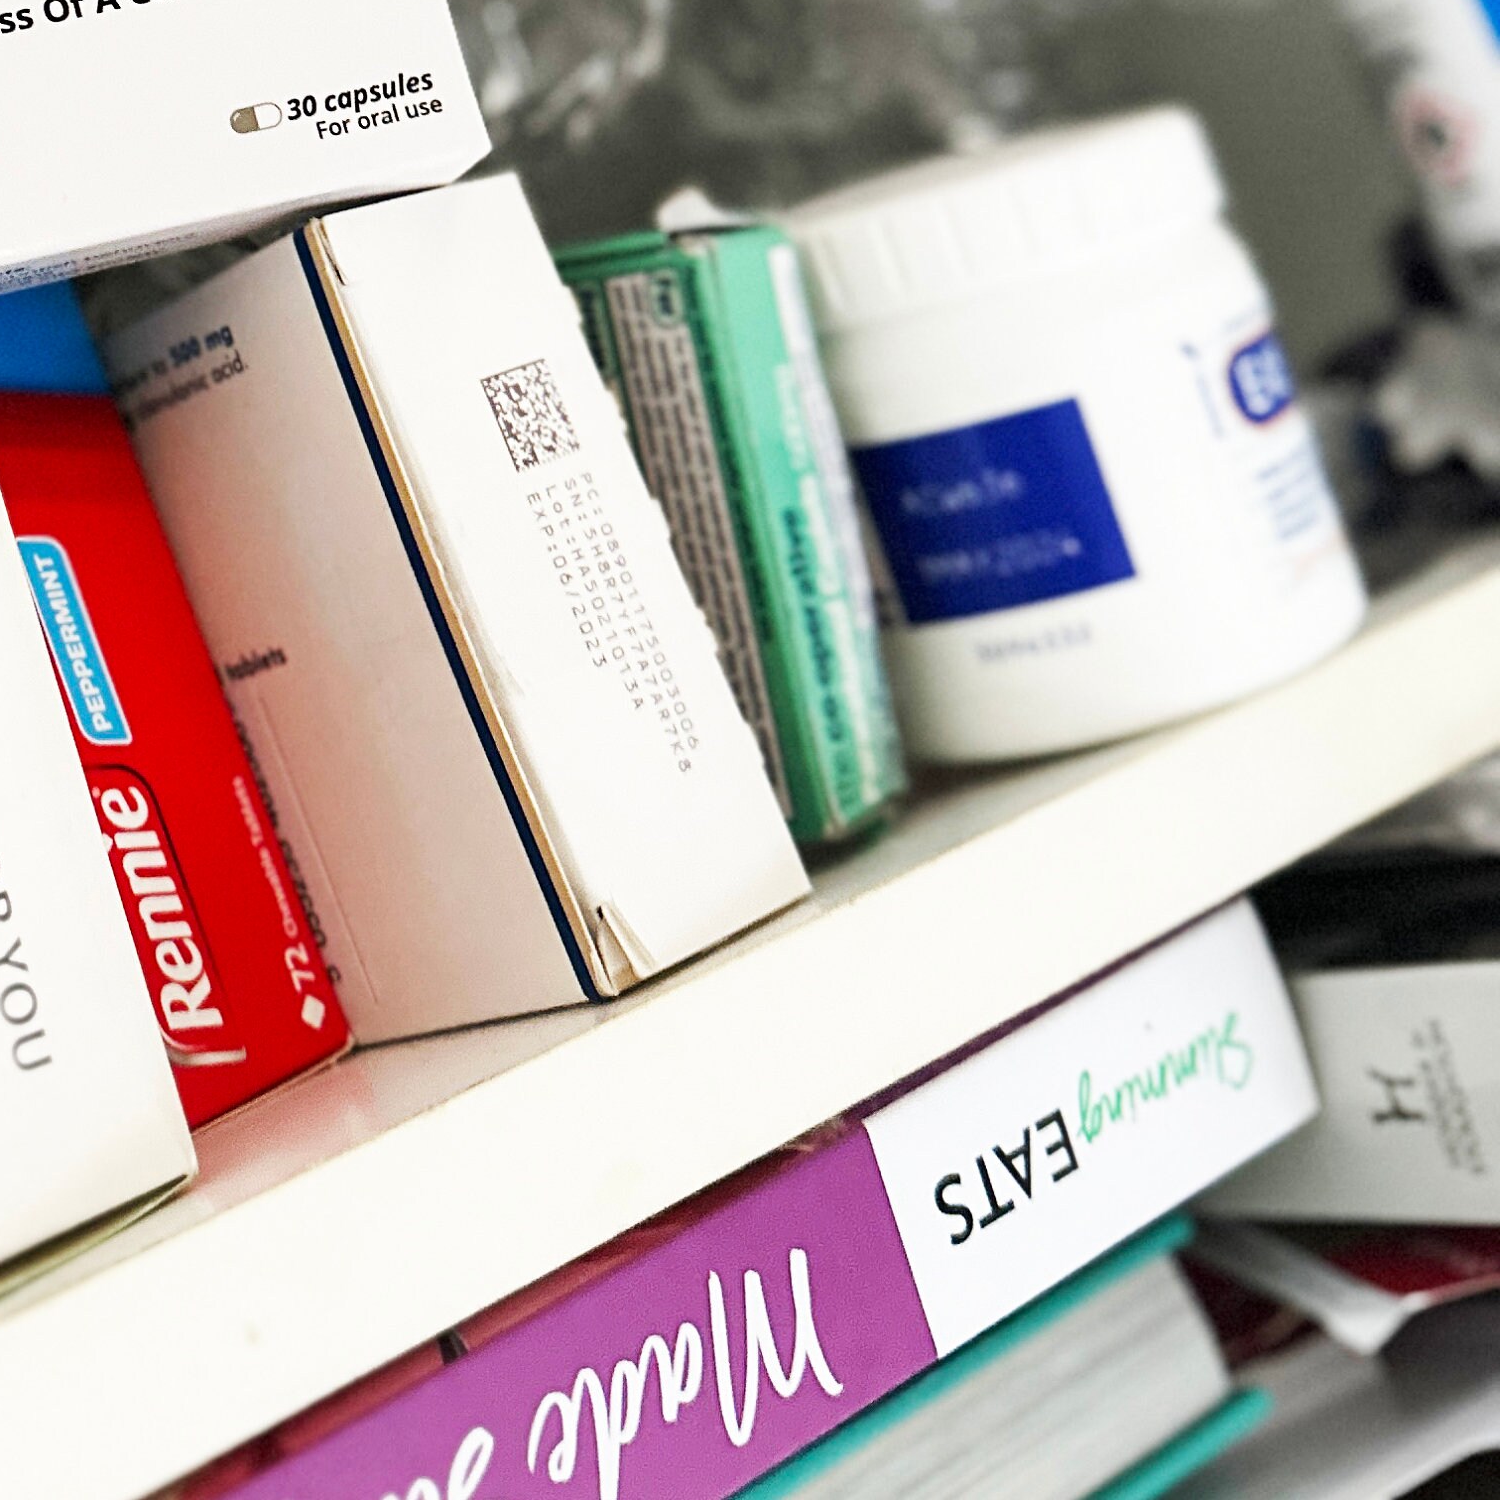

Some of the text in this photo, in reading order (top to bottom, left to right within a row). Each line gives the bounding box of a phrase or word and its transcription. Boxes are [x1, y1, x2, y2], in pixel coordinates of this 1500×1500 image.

[286, 72, 434, 121] 30 capsules
[315, 98, 443, 140] For oral use
[33, 552, 116, 736] PEPPERMINT
[100, 782, 225, 1032] Rennie
[284, 942, 316, 994] 72
[1076, 1008, 1257, 1148] Slimming
[933, 1107, 1077, 1247] EATS
[528, 1247, 844, 1500] Made
